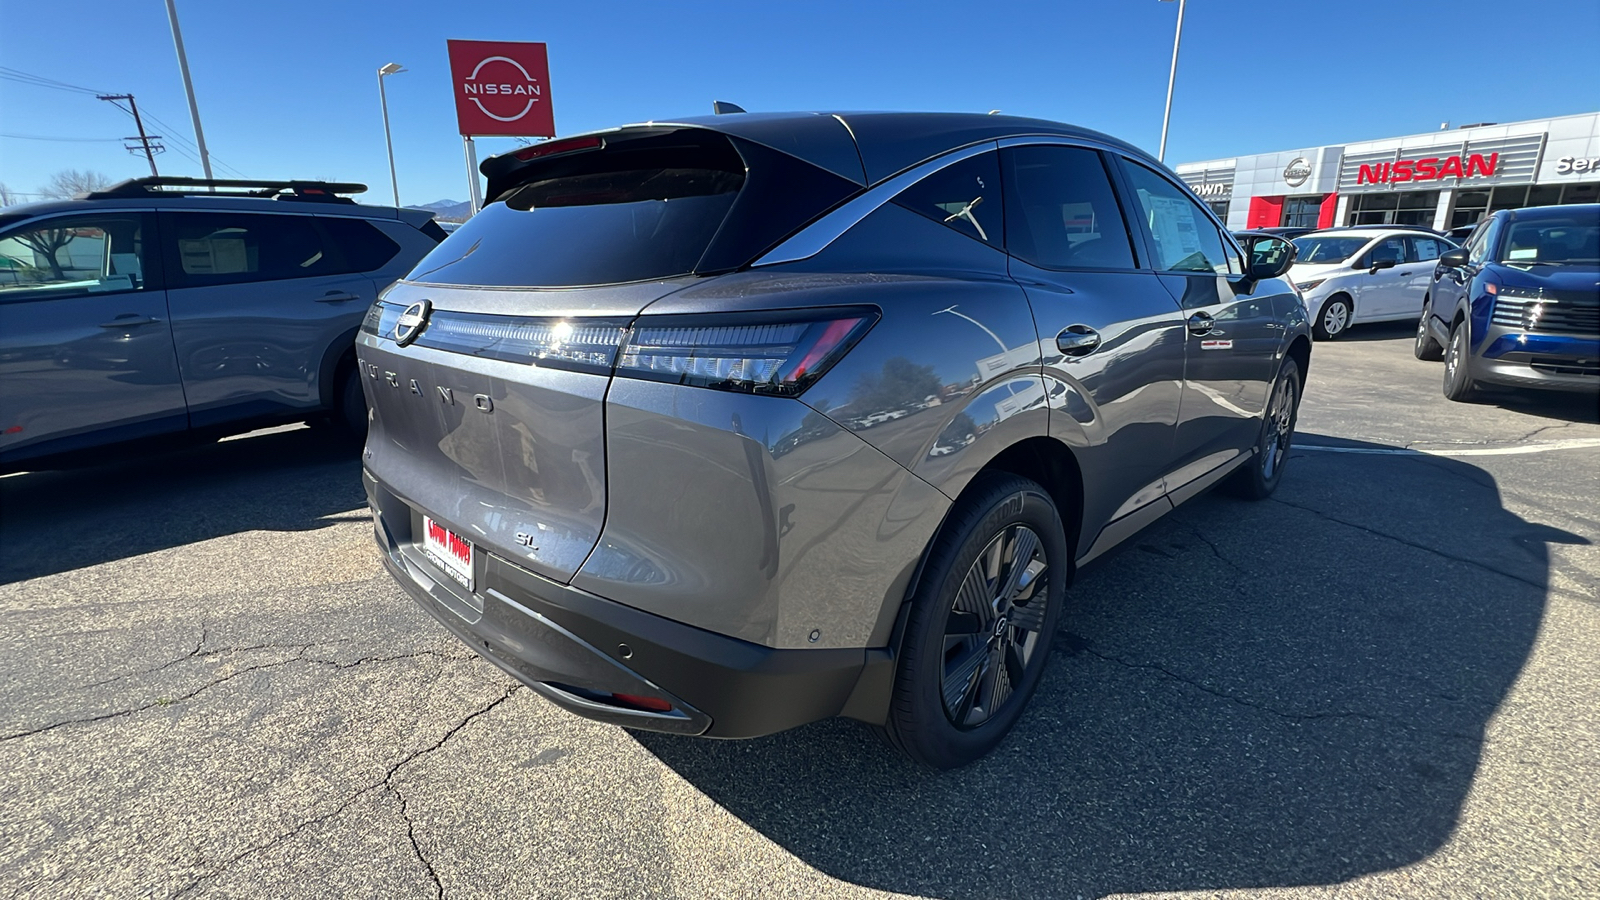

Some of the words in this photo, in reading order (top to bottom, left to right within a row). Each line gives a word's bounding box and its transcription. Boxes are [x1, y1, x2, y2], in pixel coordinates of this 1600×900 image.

[464, 83, 541, 96] NISSAN
[1357, 152, 1499, 185] NISSAN
[1190, 183, 1224, 196] own
[514, 531, 539, 551] SL
[426, 550, 445, 570] CROWN
[445, 567, 469, 588] MOTORS
